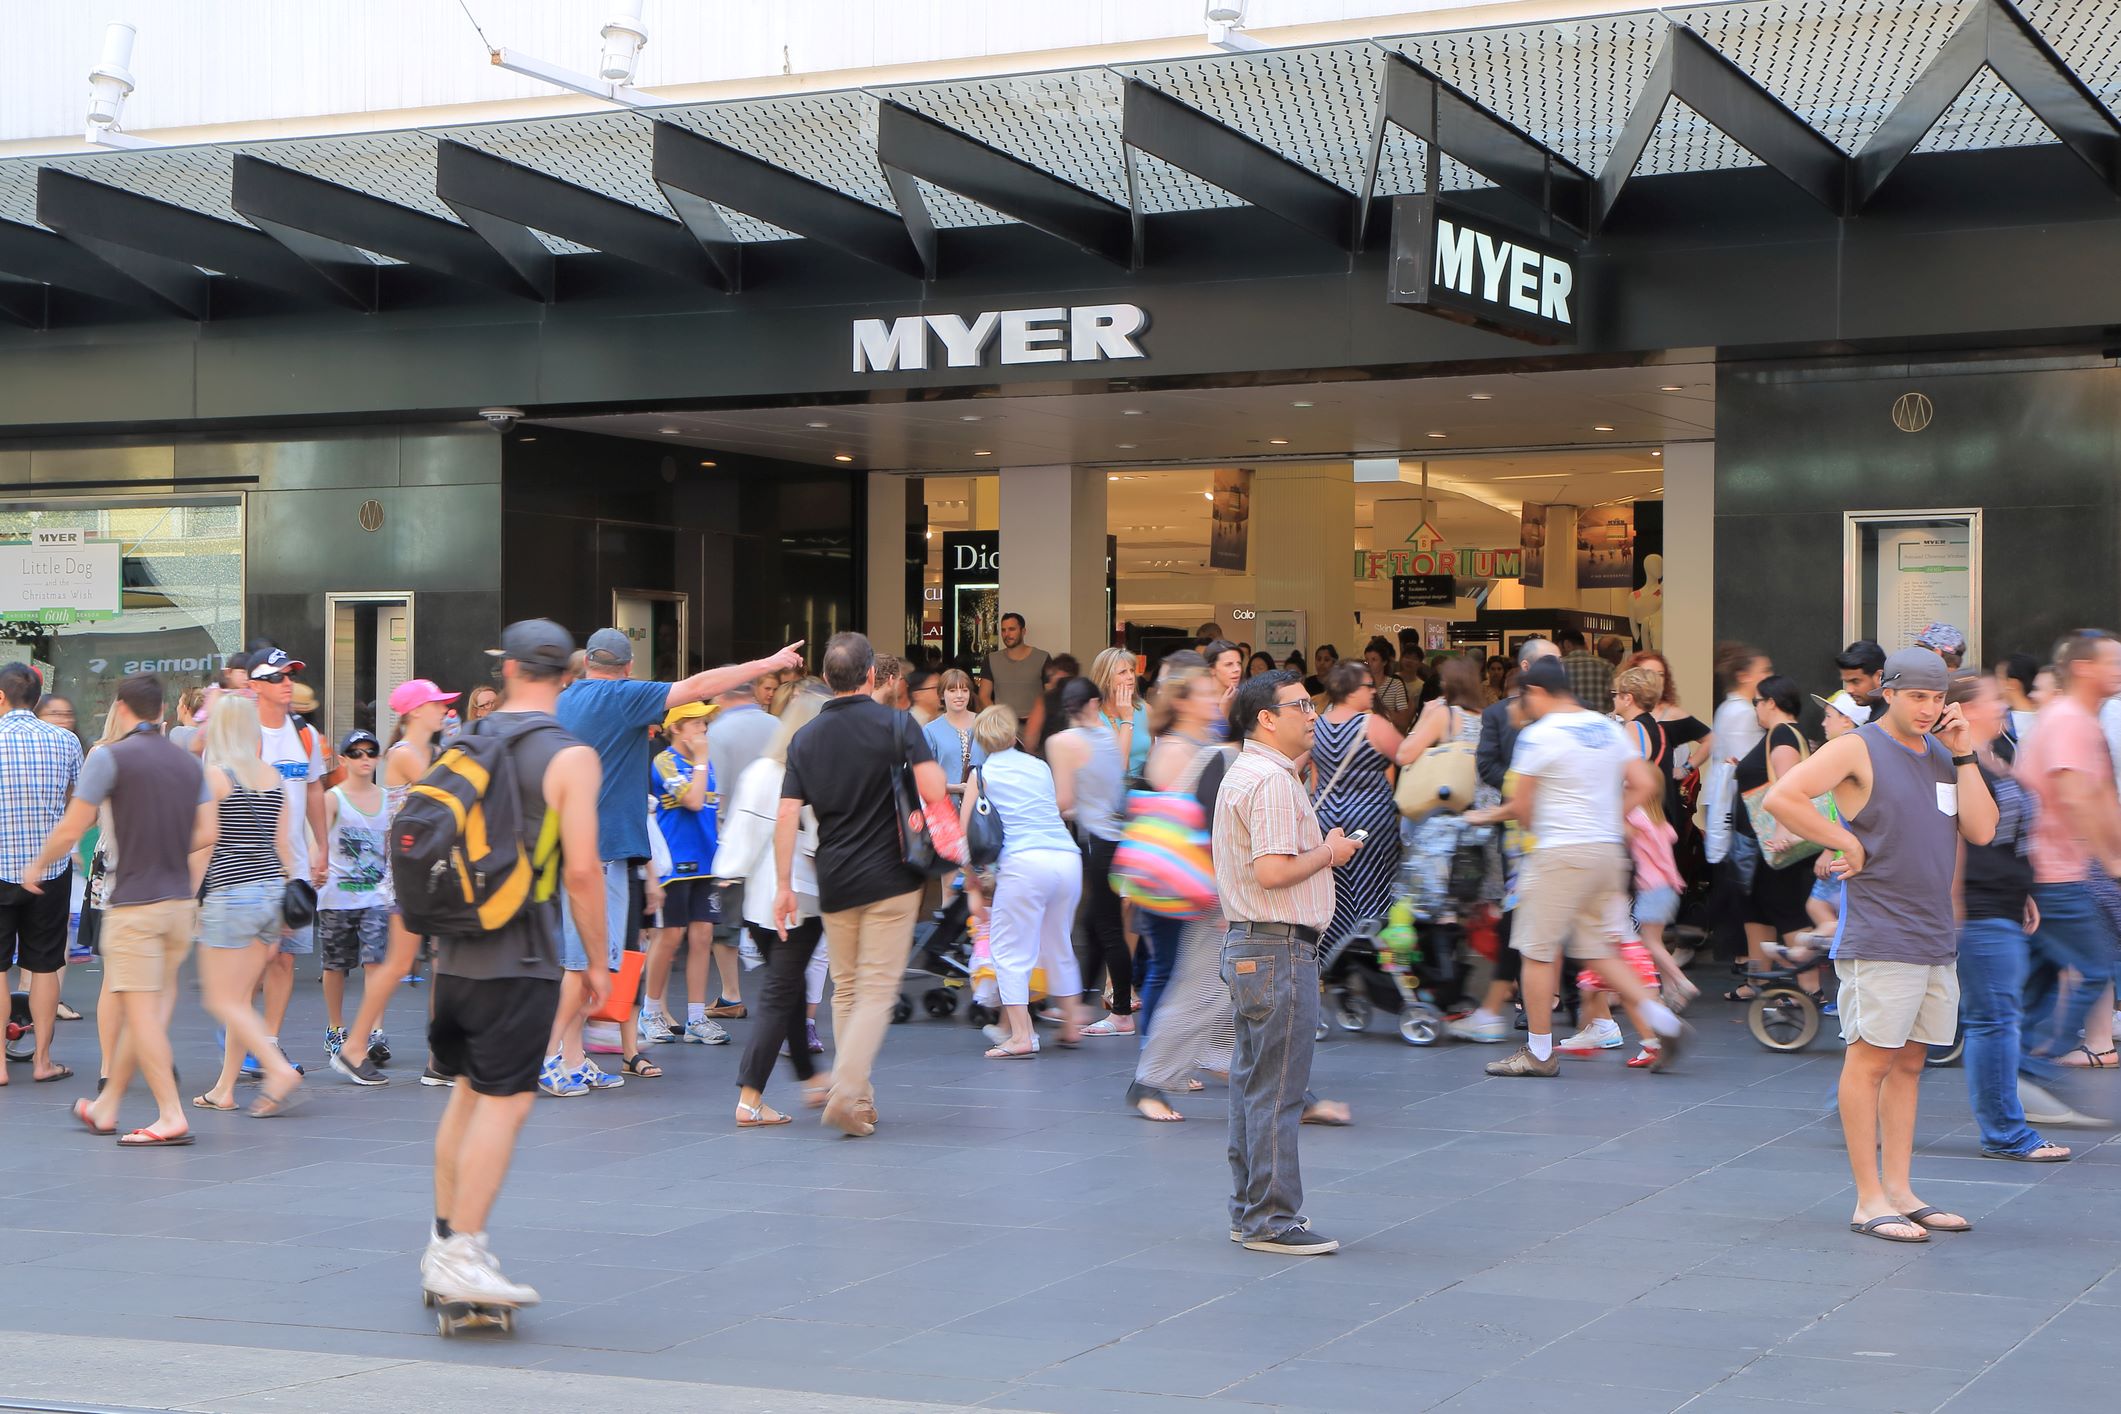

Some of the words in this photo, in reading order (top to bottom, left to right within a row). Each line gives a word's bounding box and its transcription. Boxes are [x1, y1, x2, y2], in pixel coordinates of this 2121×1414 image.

[1434, 219, 1573, 324] MYER
[852, 303, 1145, 373] MYER
[39, 533, 77, 542] MYER
[22, 557, 60, 575] Little
[65, 557, 93, 580] Dog
[22, 589, 66, 601] Christmas
[70, 588, 93, 600] Wish
[44, 609, 70, 622] 60th
[1233, 609, 1256, 620] Colo
[1374, 623, 1392, 633] Skin
